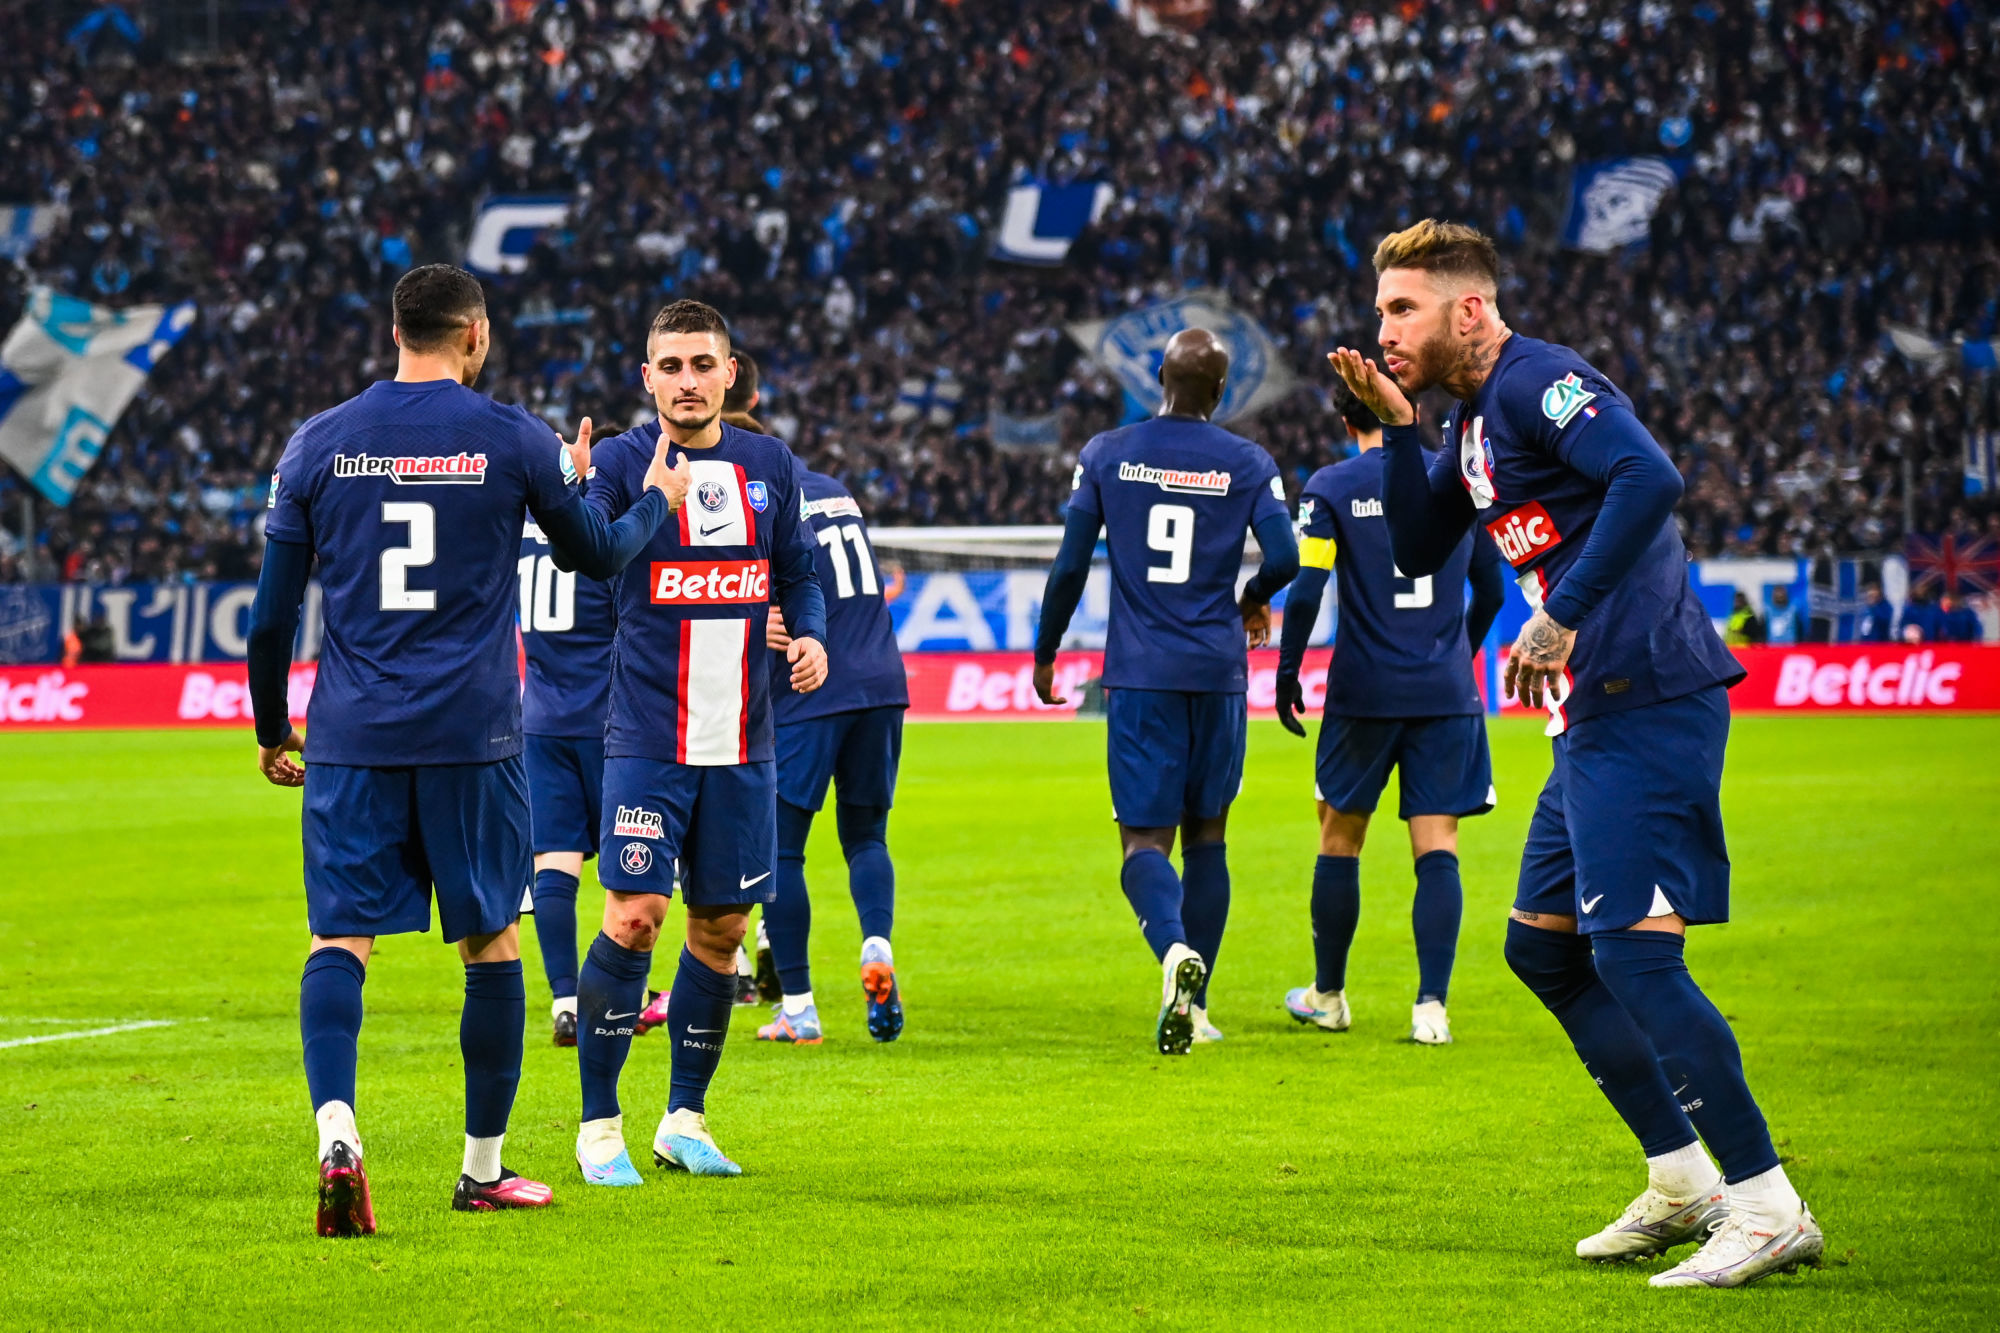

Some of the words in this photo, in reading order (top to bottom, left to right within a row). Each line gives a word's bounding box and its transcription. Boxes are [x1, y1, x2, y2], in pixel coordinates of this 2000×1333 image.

[380, 501, 437, 611] 2
[817, 524, 879, 599] 11
[1147, 504, 1195, 584] 9
[517, 554, 576, 633] 10
[656, 564, 767, 599] Betclic
[1774, 650, 1962, 706] Betclic
[616, 807, 662, 829] Inter
[595, 1027, 634, 1037] PARIS
